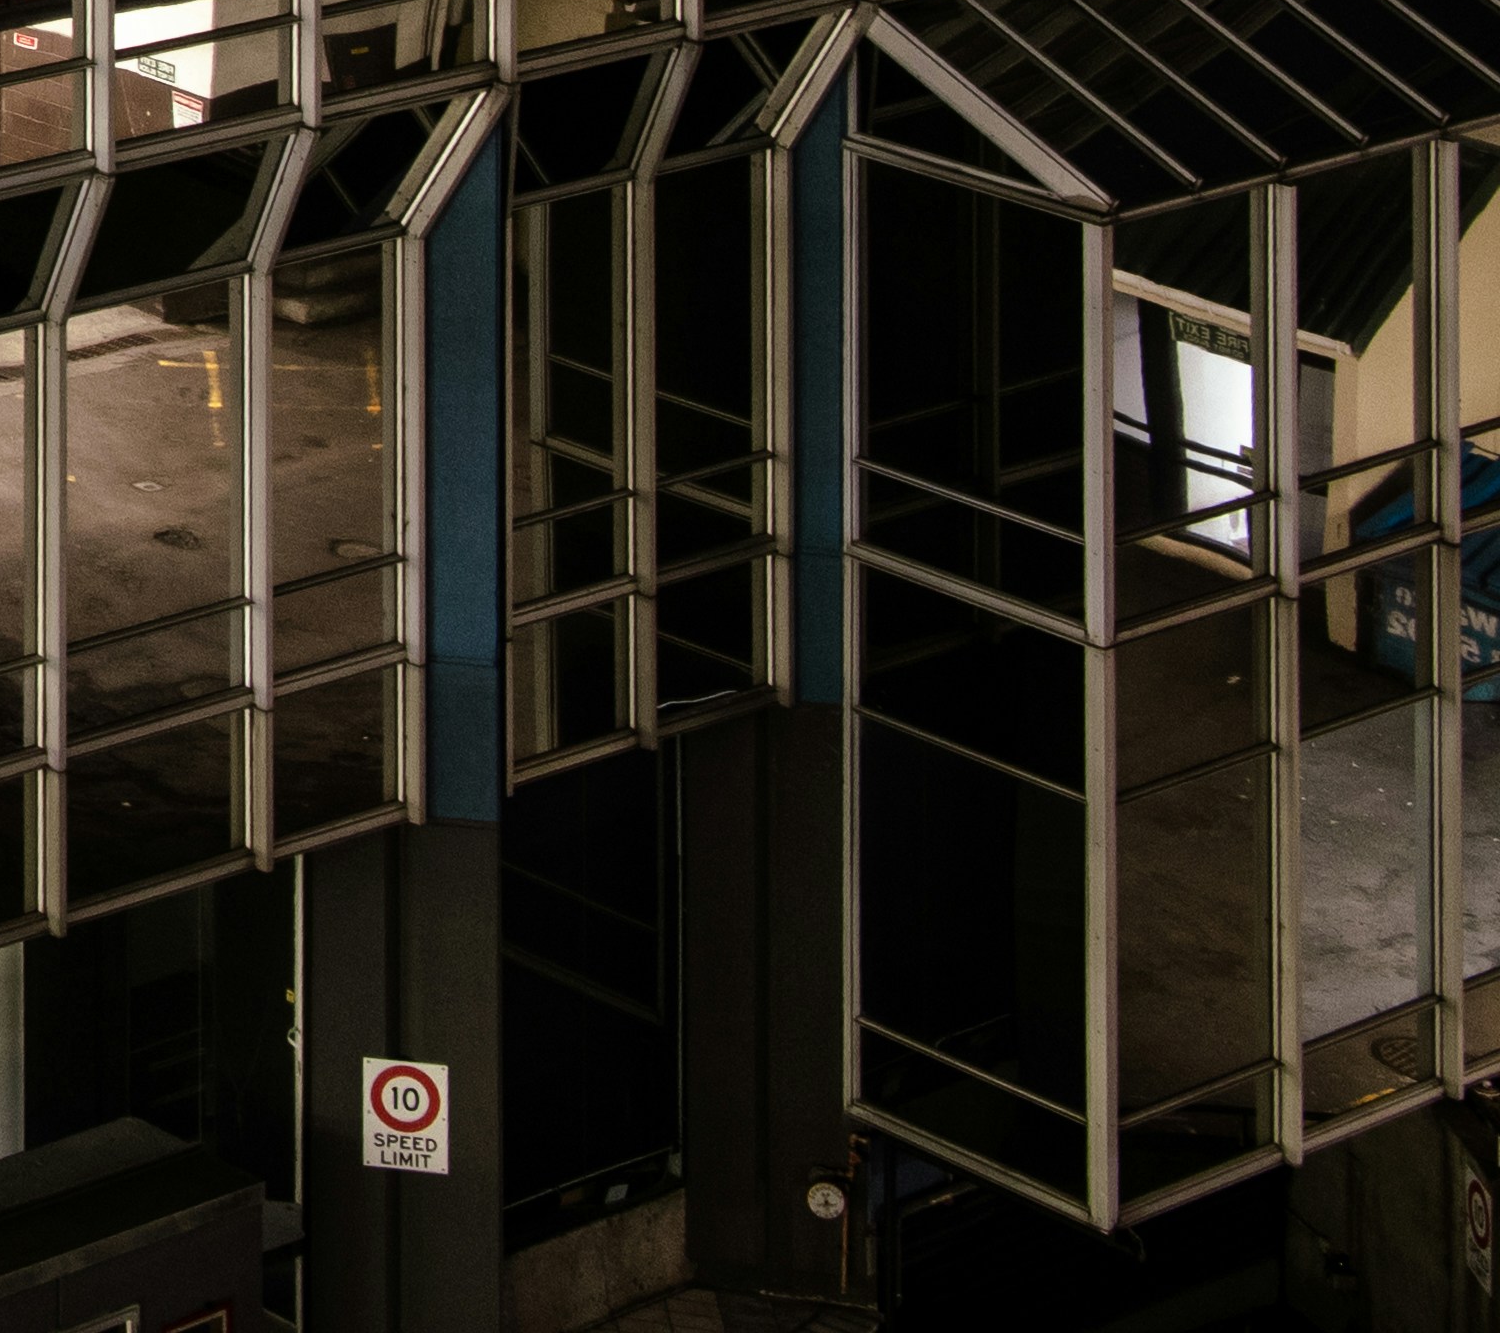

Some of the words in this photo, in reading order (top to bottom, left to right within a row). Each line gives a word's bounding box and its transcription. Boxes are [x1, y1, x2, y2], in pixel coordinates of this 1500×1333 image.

[391, 1086, 420, 1112] 10
[373, 1133, 438, 1153] SPEED
[380, 1150, 432, 1169] LIMIT
